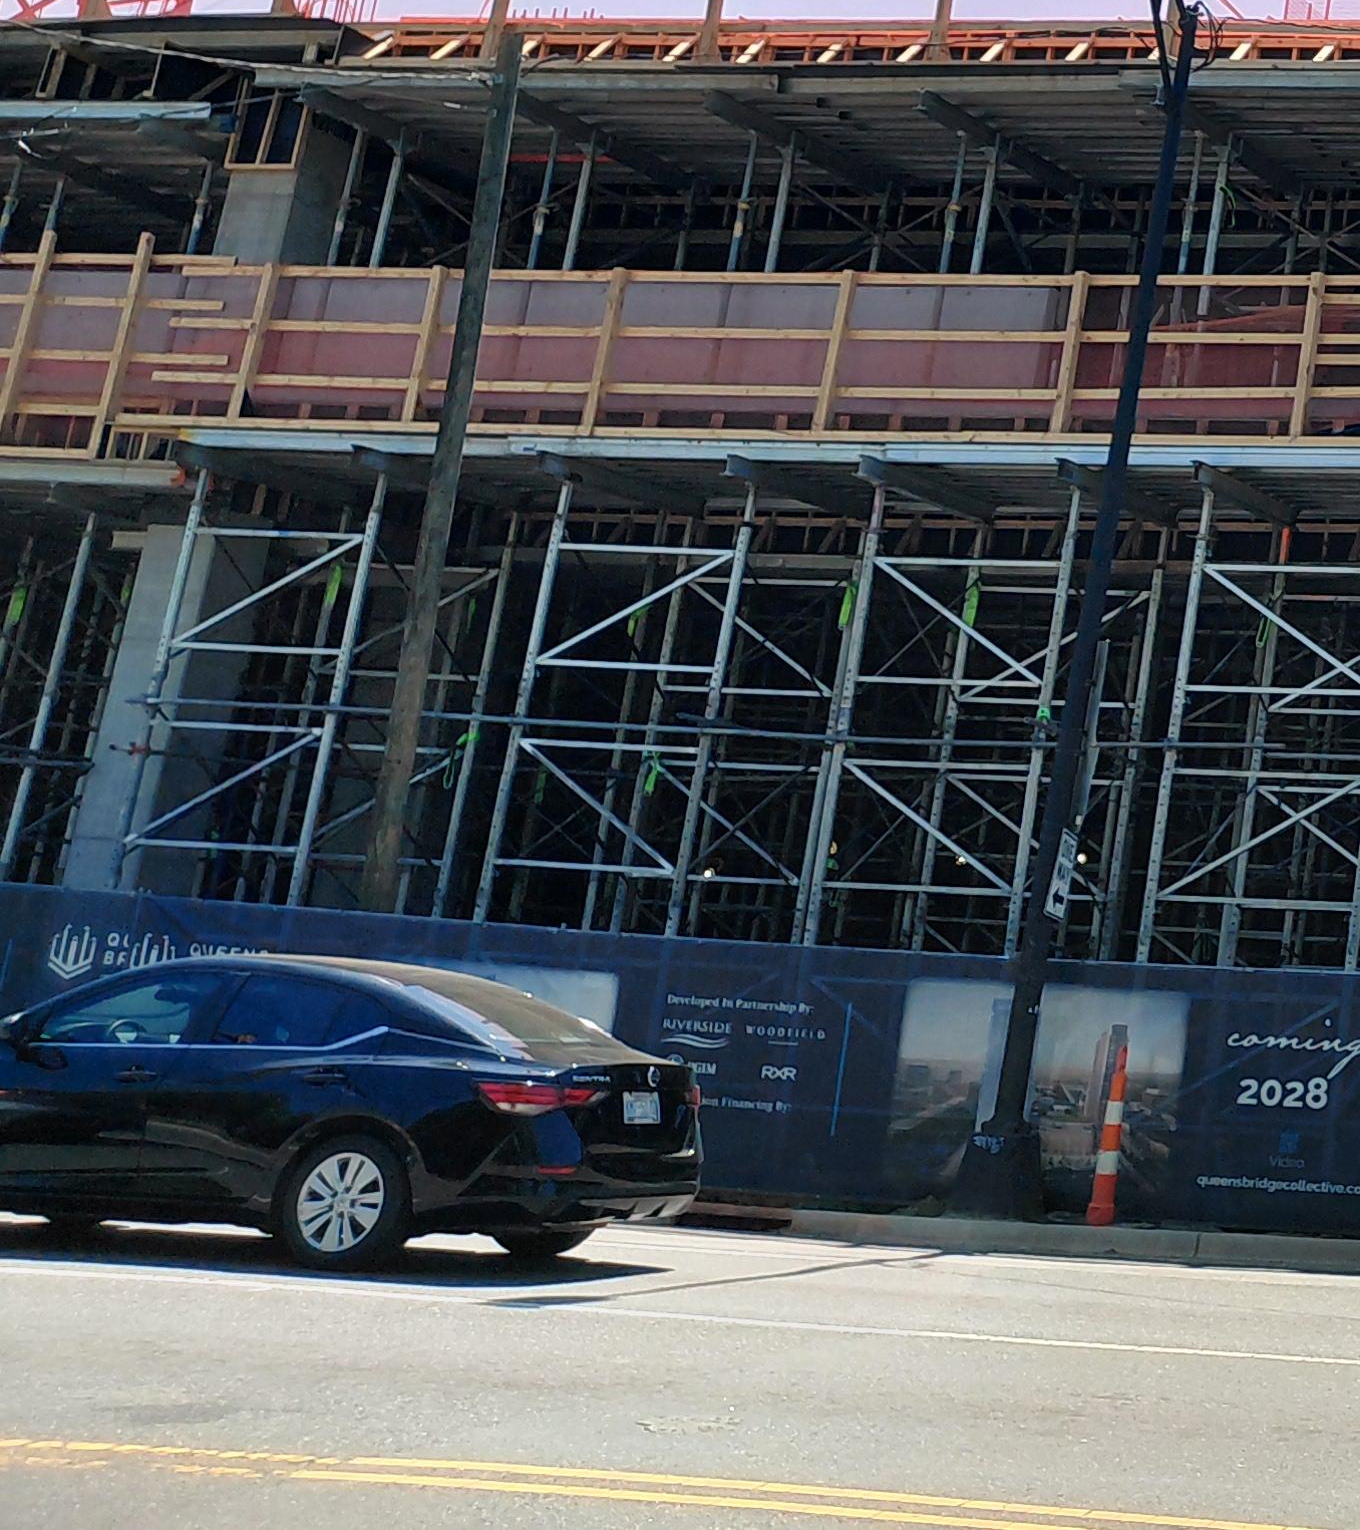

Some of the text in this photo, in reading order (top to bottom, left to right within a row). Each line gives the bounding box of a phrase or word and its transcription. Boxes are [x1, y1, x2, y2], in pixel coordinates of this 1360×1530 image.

[667, 993, 720, 1009] Developed
[721, 997, 733, 1008] In
[735, 998, 796, 1014] Partnership
[663, 1019, 732, 1034] RIVERSIDE
[745, 1025, 826, 1040] WOODFIELD
[761, 1065, 797, 1081] RXR
[1237, 1077, 1328, 1109] 2028
[721, 1096, 773, 1113] Financing
